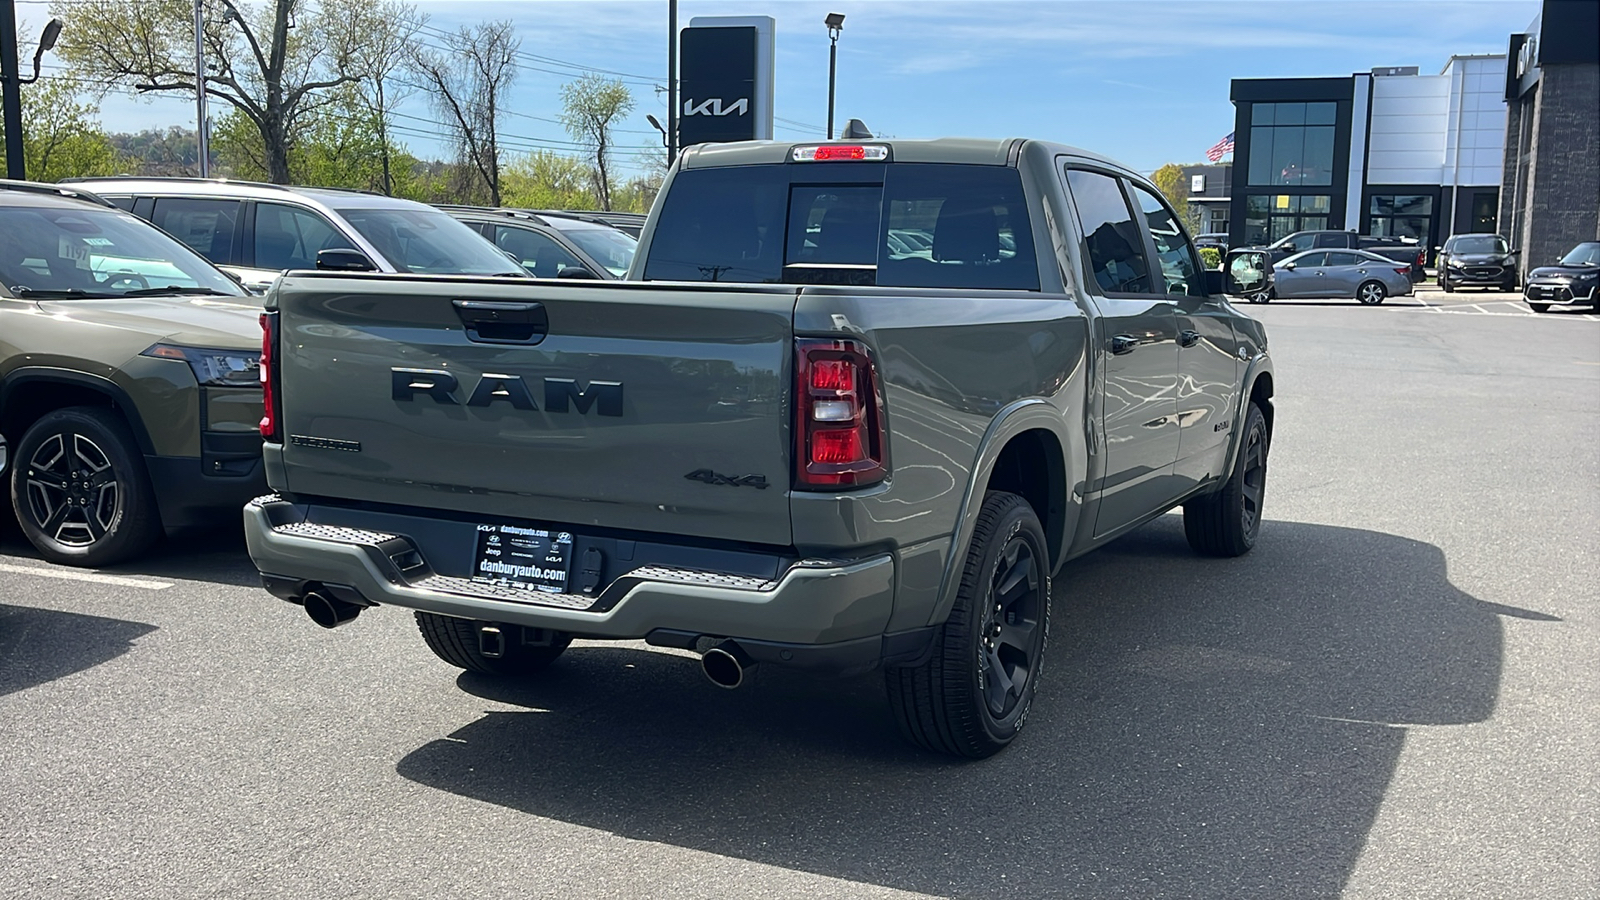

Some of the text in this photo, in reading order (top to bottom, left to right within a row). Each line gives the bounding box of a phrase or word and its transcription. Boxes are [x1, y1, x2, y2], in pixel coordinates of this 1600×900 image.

[684, 98, 748, 116] KIA
[391, 366, 624, 417] RAM
[486, 548, 501, 556] Jeep
[480, 559, 566, 580] danburyauto.com
